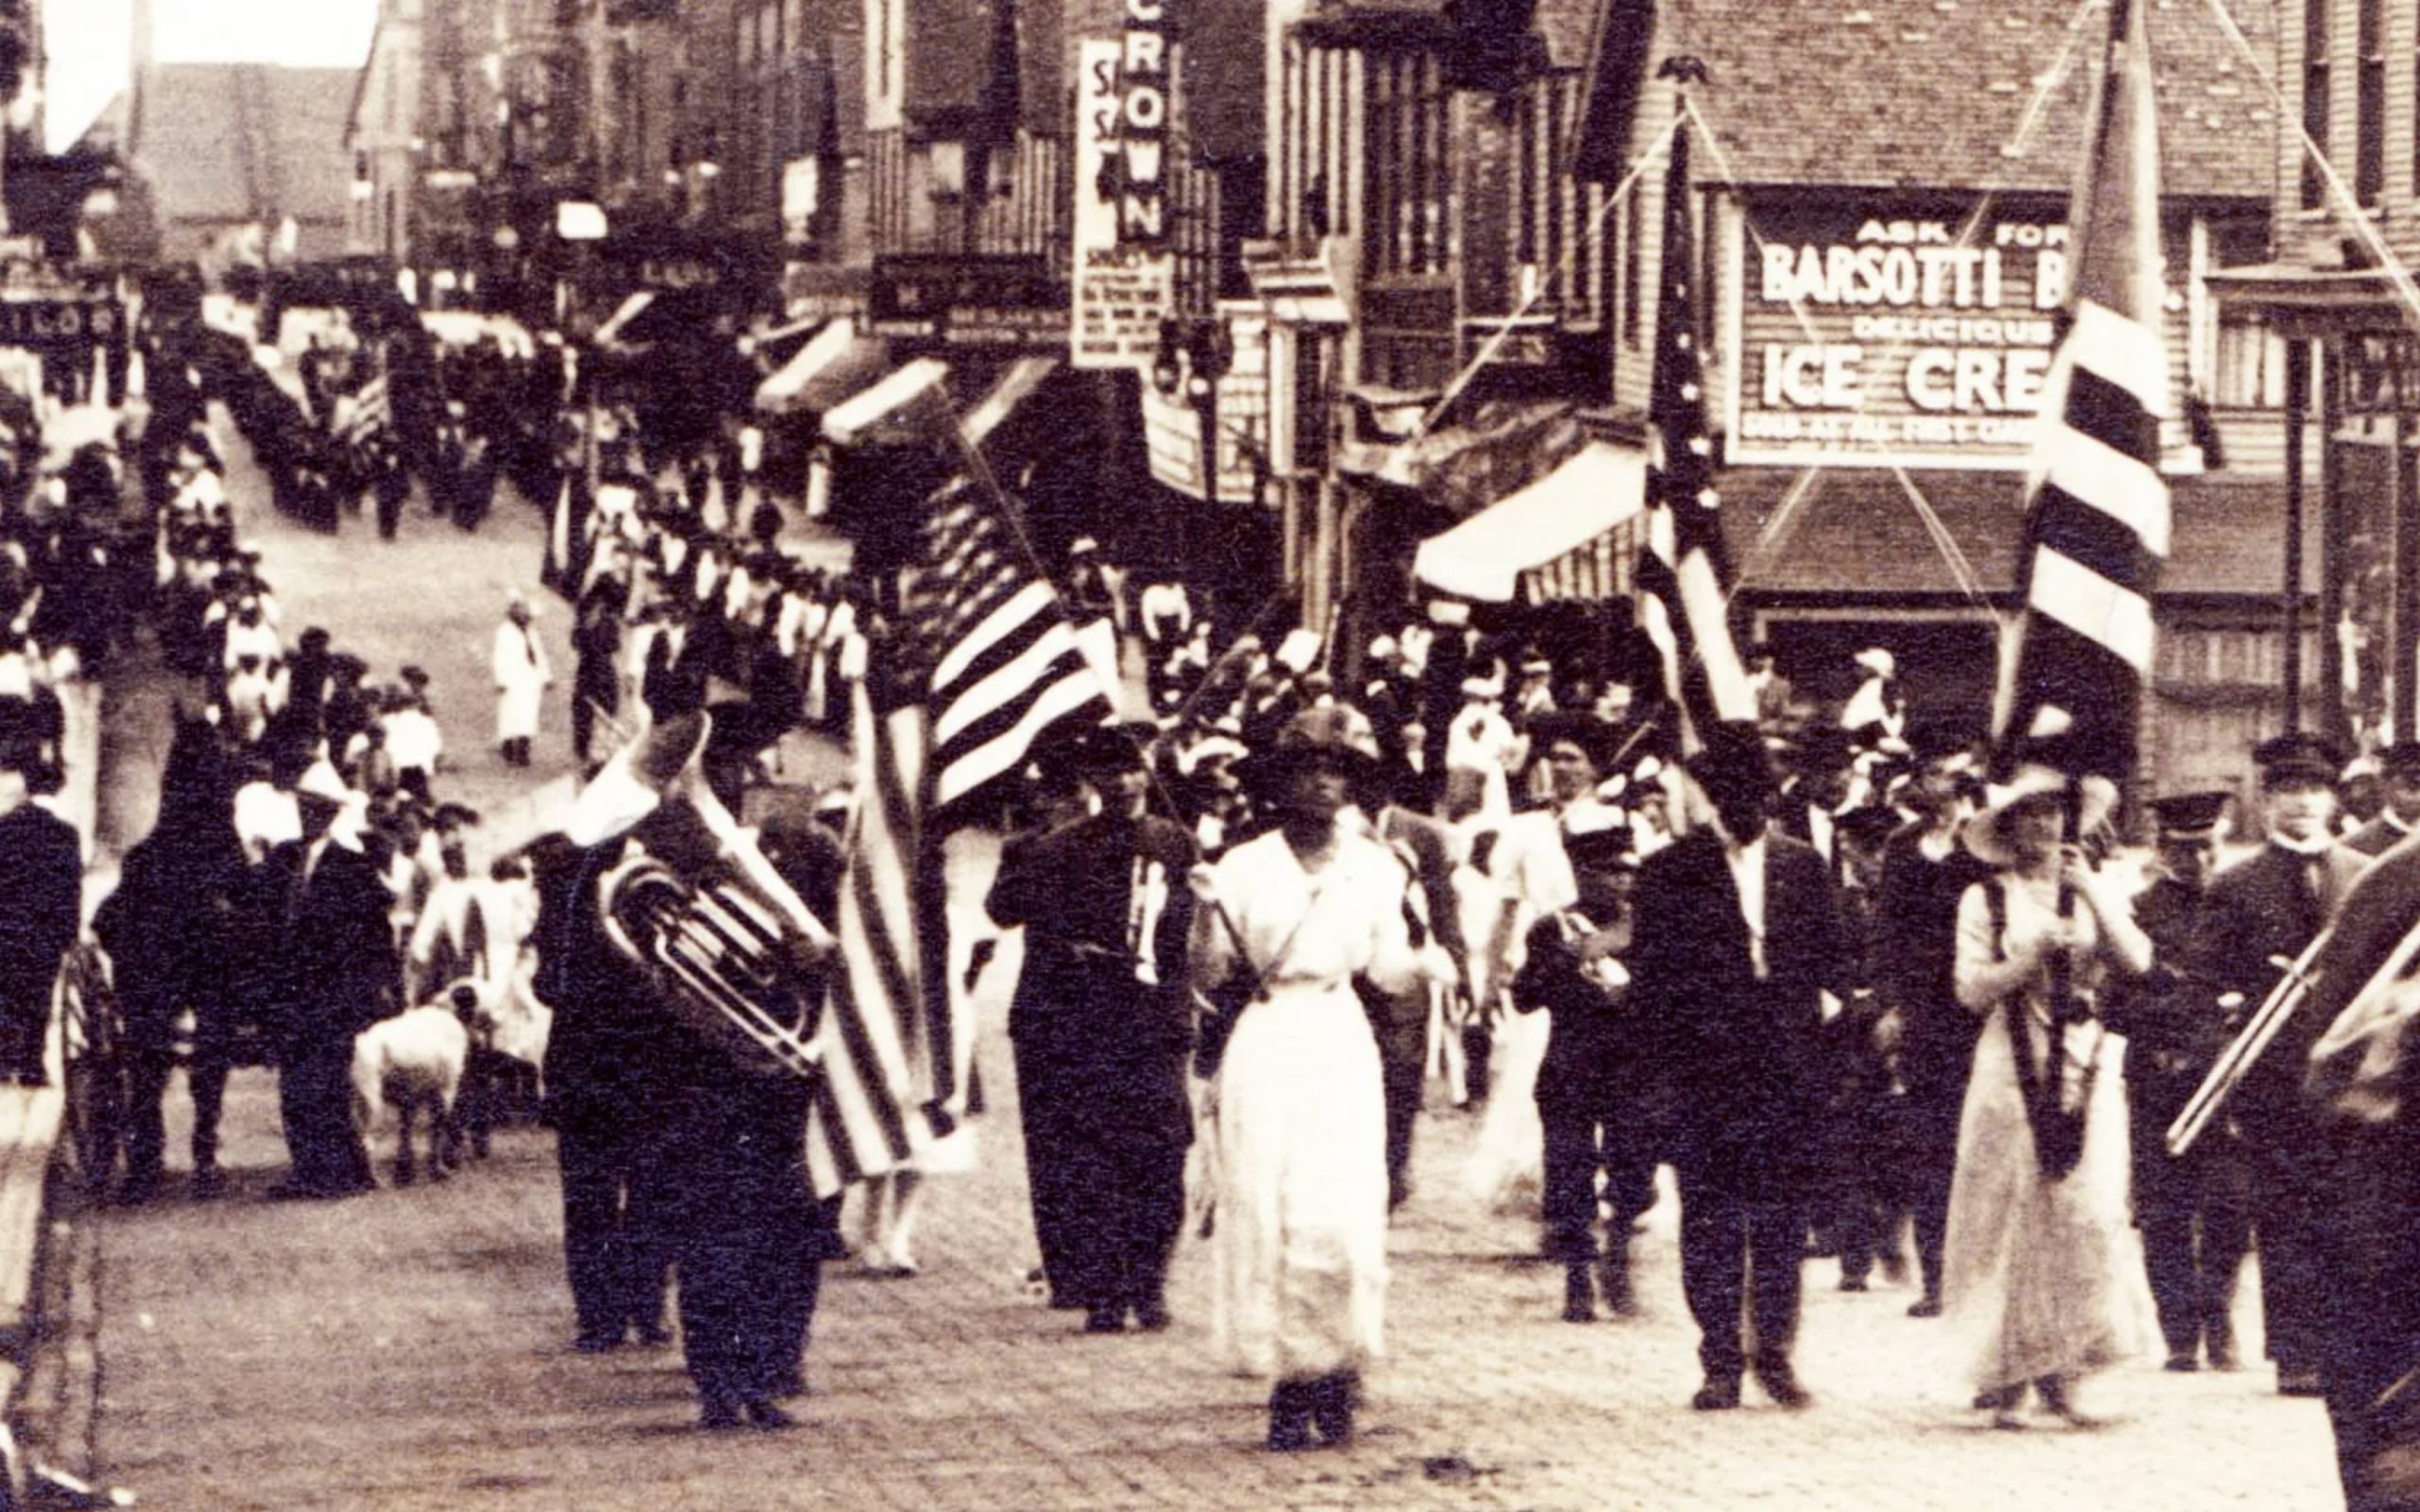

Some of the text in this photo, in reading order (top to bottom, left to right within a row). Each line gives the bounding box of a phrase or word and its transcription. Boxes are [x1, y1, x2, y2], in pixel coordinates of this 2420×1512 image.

[1856, 218, 2068, 247] ASK FOR
[1762, 243, 2001, 308] BARSOTTI
[1854, 316, 2053, 344] DELICIOUS
[1763, 342, 2049, 412] ICE CRE
